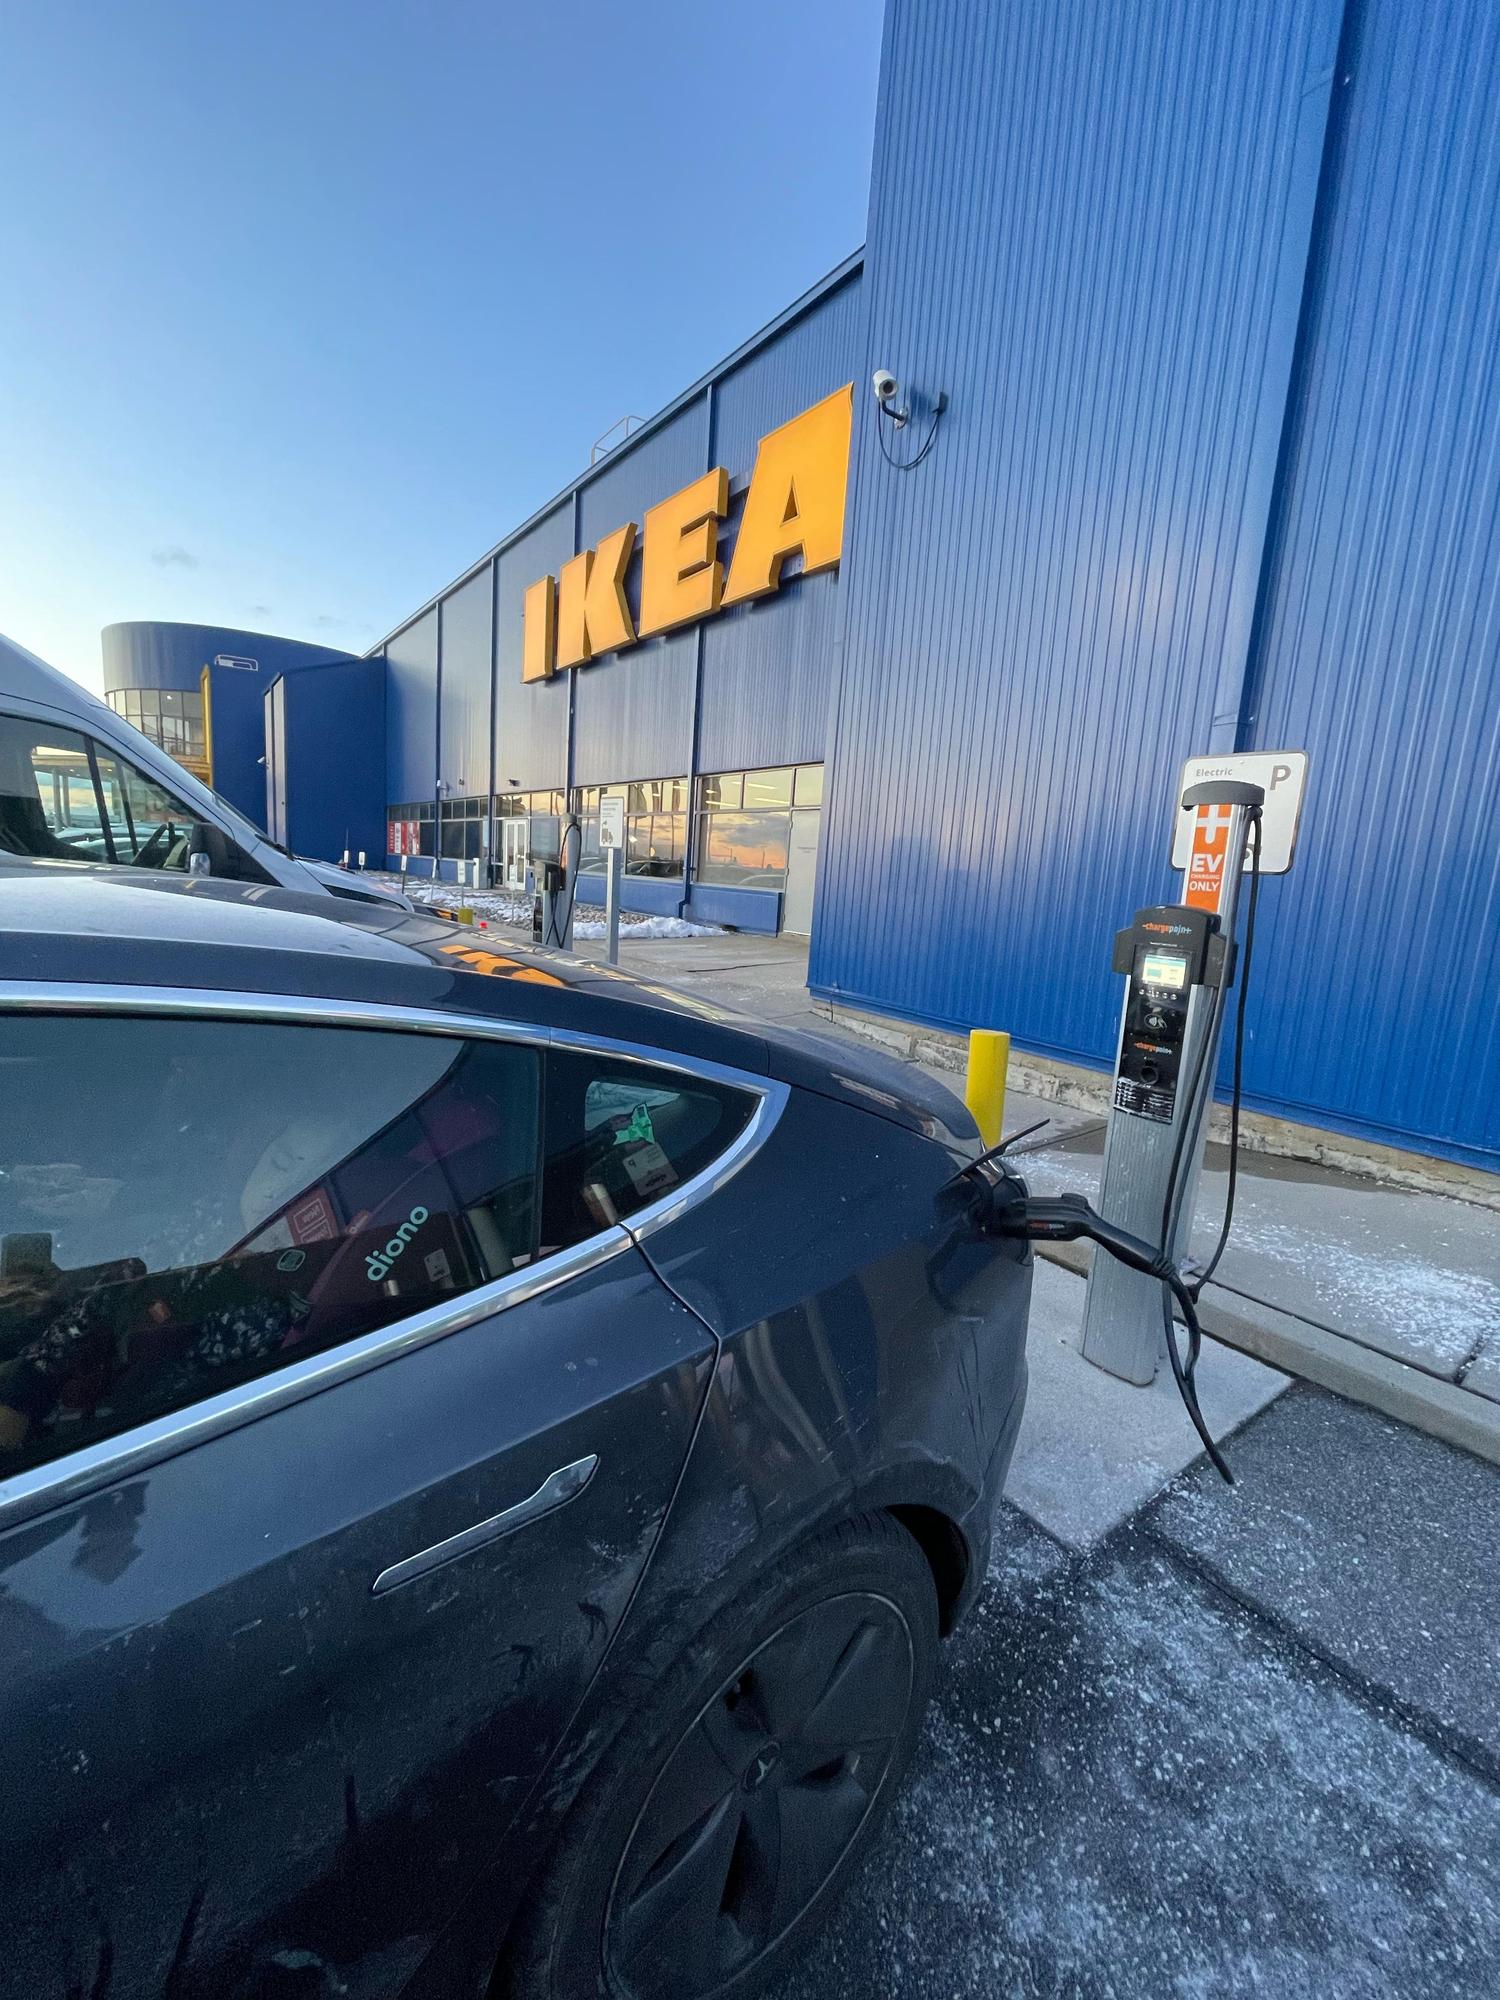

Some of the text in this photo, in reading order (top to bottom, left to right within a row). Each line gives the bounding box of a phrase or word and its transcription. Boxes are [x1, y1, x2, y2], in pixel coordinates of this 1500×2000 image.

[520, 381, 854, 684] IKEA
[1195, 767, 1234, 778] Electric
[1269, 764, 1292, 791] P
[1192, 853, 1223, 873] EV
[1189, 880, 1220, 892] ONLY
[365, 1206, 429, 1281] diono
